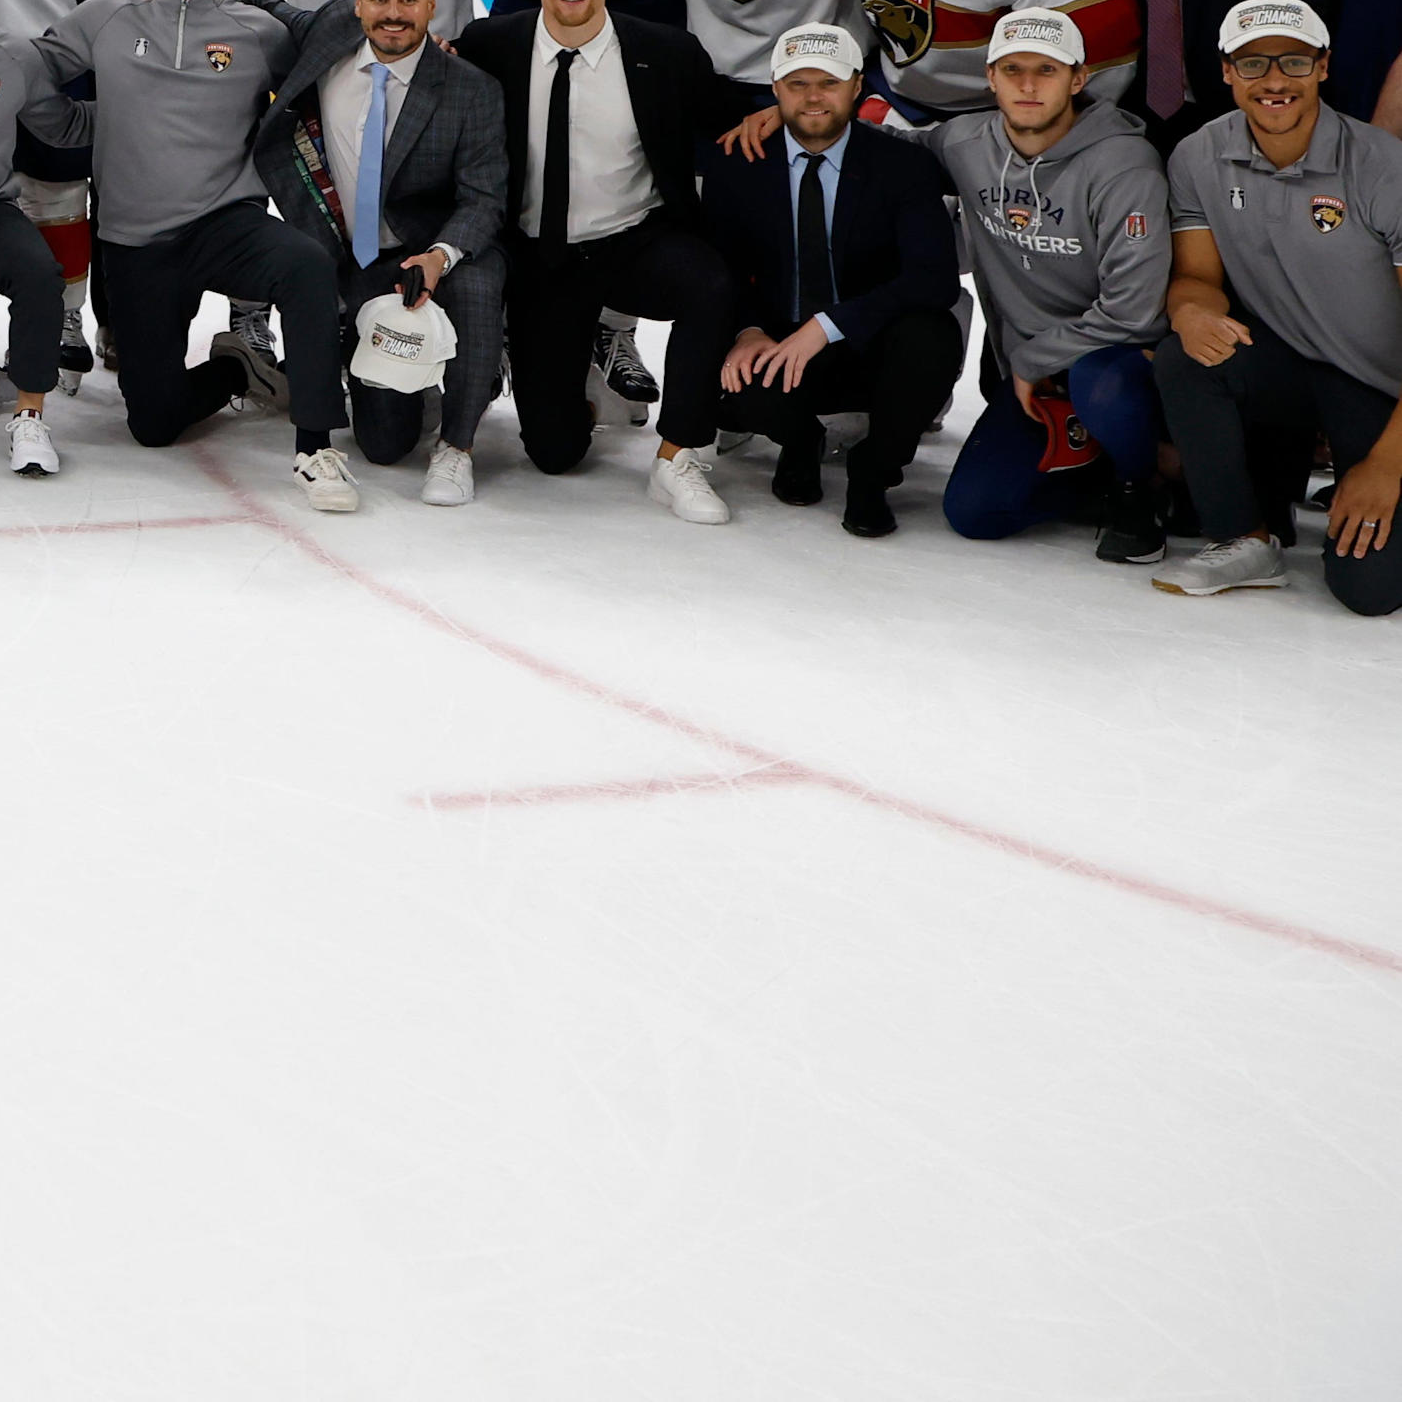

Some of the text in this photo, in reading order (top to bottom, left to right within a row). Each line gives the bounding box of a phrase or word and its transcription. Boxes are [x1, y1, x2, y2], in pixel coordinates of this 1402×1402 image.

[1256, 7, 1303, 28] CHAMPS
[1021, 24, 1062, 43] CHAMPS
[799, 39, 839, 56] CHAMPS
[382, 336, 424, 359] CHAMPS
